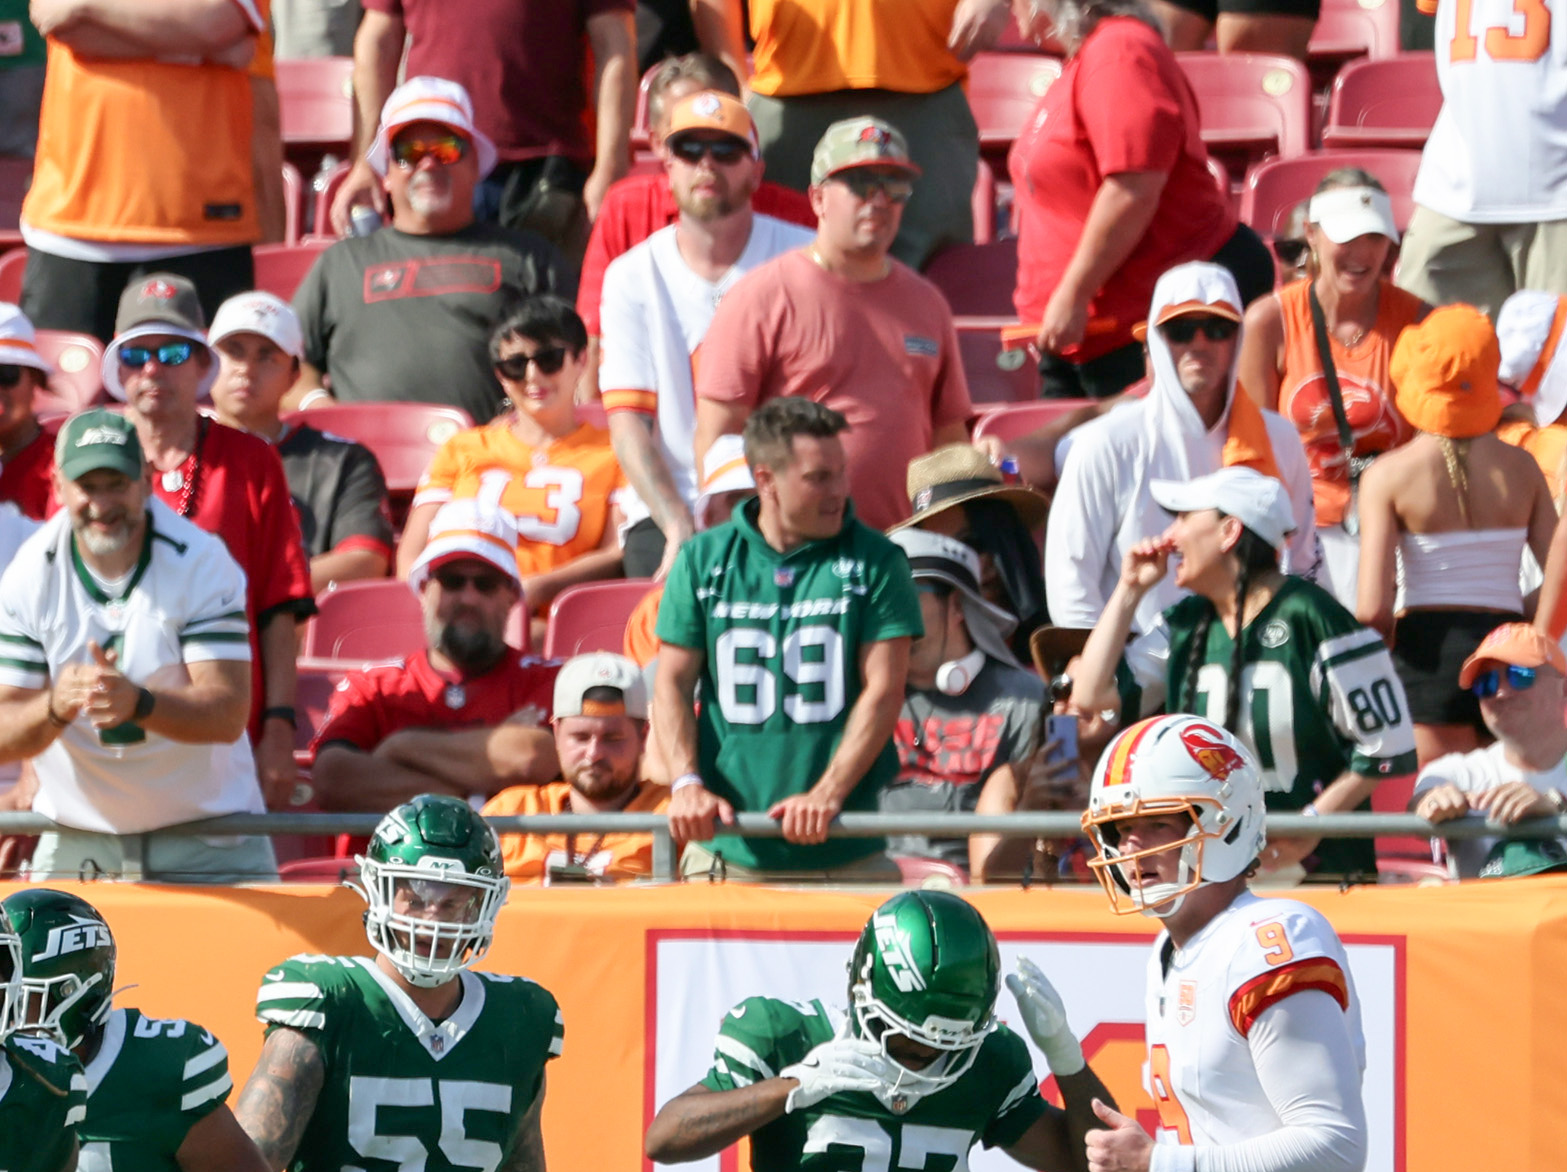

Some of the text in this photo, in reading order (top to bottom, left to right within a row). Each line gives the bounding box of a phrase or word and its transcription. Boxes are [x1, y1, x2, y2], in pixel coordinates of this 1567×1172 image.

[475, 466, 585, 546] 13
[712, 601, 779, 620] NEW
[715, 624, 845, 725] 69
[1347, 677, 1403, 733] 80
[430, 860, 455, 869] NY
[31, 913, 112, 963] JETS
[872, 909, 928, 993] JETS
[1255, 921, 1294, 967] 9
